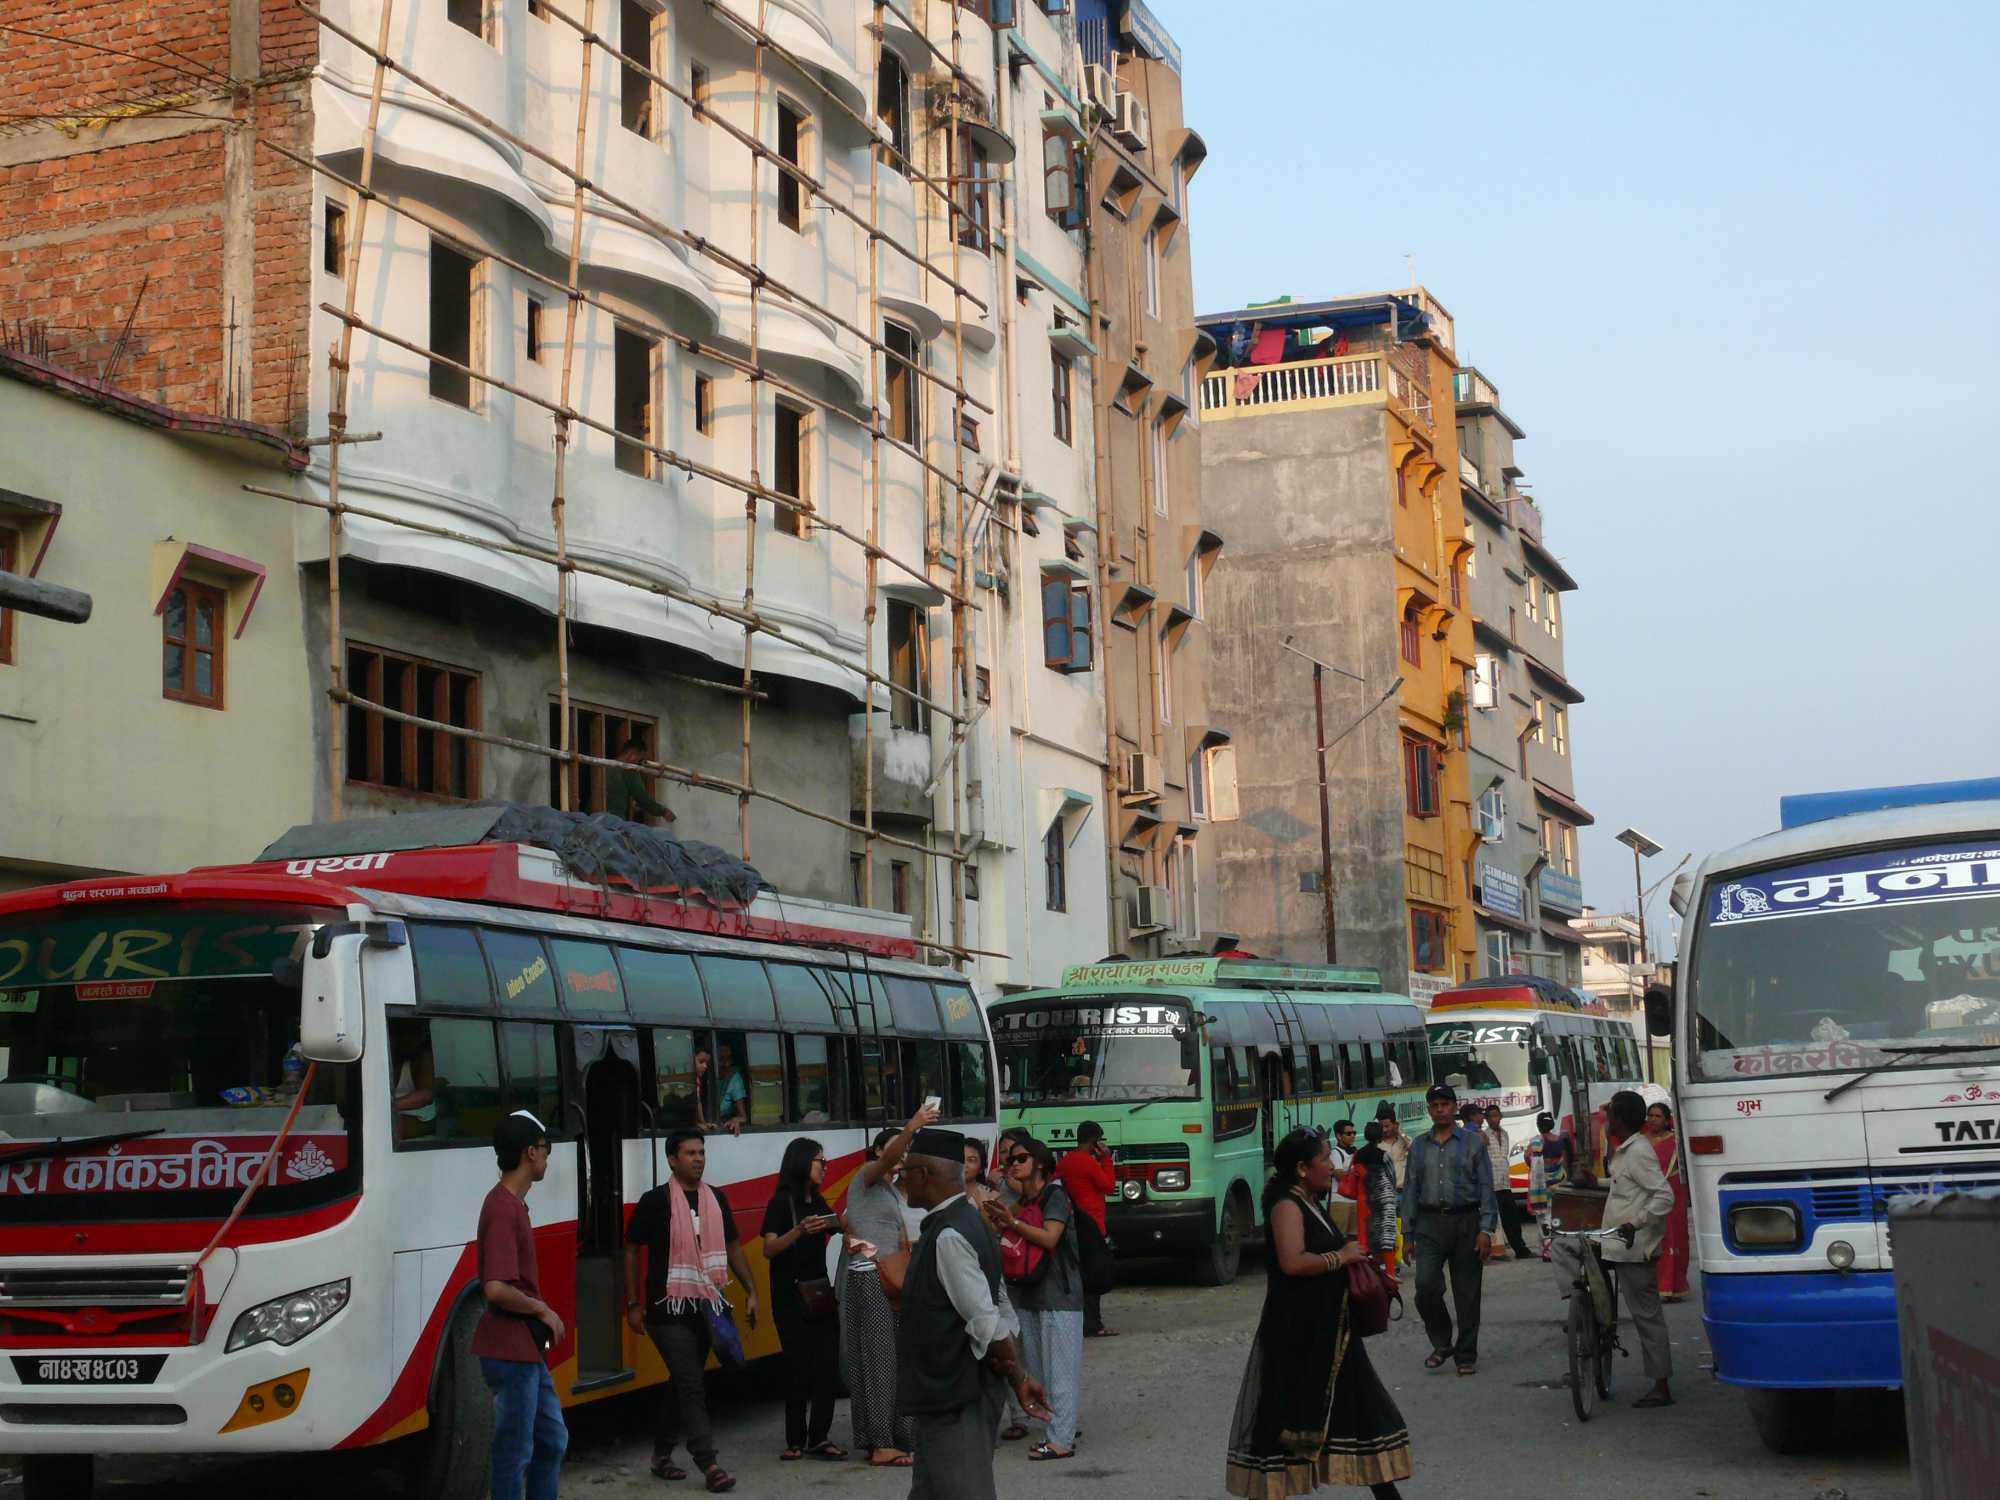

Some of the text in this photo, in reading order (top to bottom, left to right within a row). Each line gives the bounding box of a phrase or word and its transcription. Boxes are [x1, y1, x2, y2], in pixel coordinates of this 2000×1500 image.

[1004, 1006, 1165, 1030] TOURIST
[1737, 1098, 1761, 1116] शुभ
[1935, 1119, 2000, 1142] TAT
